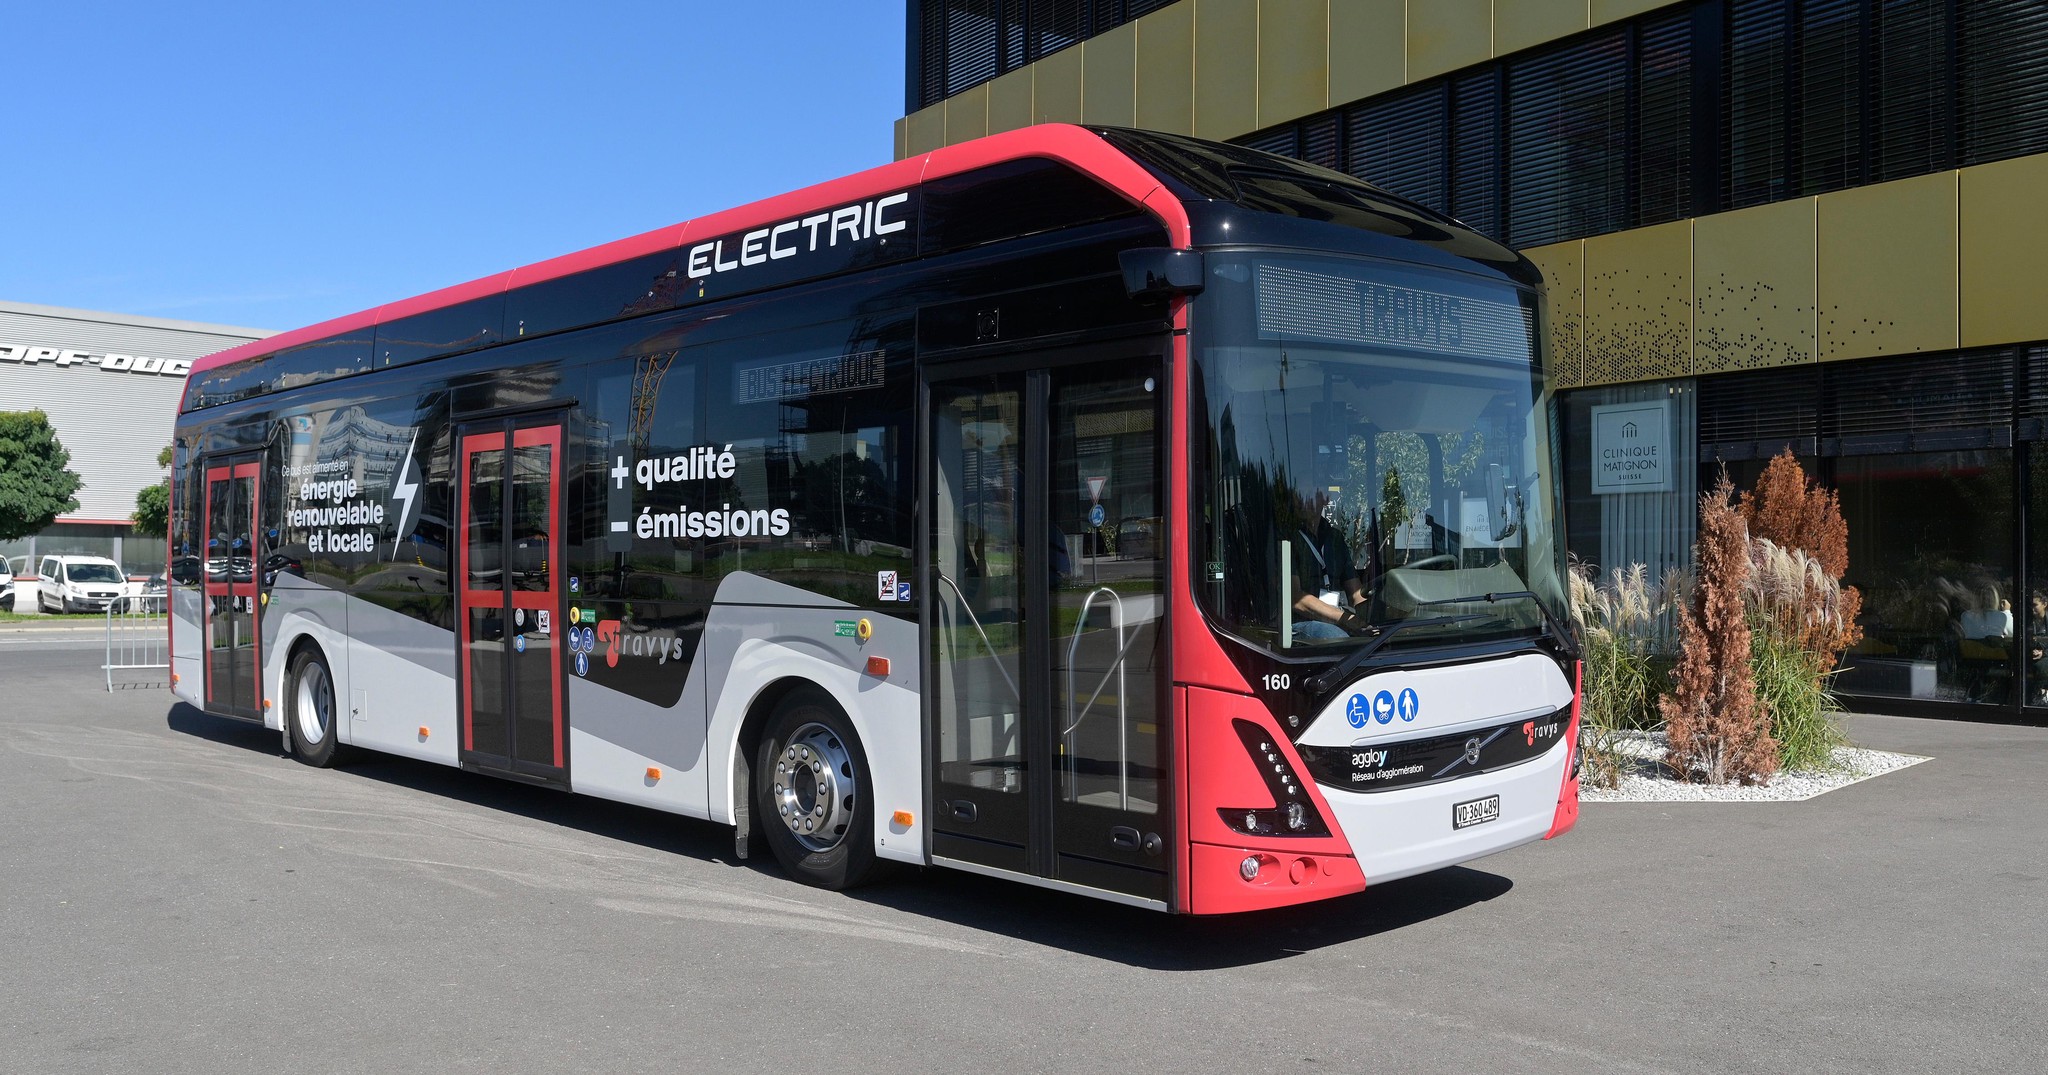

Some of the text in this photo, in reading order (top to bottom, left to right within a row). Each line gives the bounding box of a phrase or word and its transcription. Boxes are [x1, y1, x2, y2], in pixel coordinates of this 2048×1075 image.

[687, 192, 908, 279] ELECTRIC
[1354, 282, 1461, 346] TRAVYS
[749, 366, 777, 399] BUS
[1603, 446, 1657, 459] CLINIQUE
[282, 459, 348, 477] Ce bus est alimenté en
[636, 444, 736, 491] qualité
[1603, 460, 1657, 472] MATIGNON
[1618, 473, 1642, 481] SUISSE
[300, 474, 358, 504] énergie
[288, 500, 384, 527] renouvelable
[636, 503, 790, 539] émissions
[308, 528, 374, 553] et locale
[1262, 673, 1290, 690] 160
[1352, 749, 1387, 768] aggloy
[1352, 764, 1423, 782] Réseau d'agglomération
[1484, 799, 1497, 815] 489
